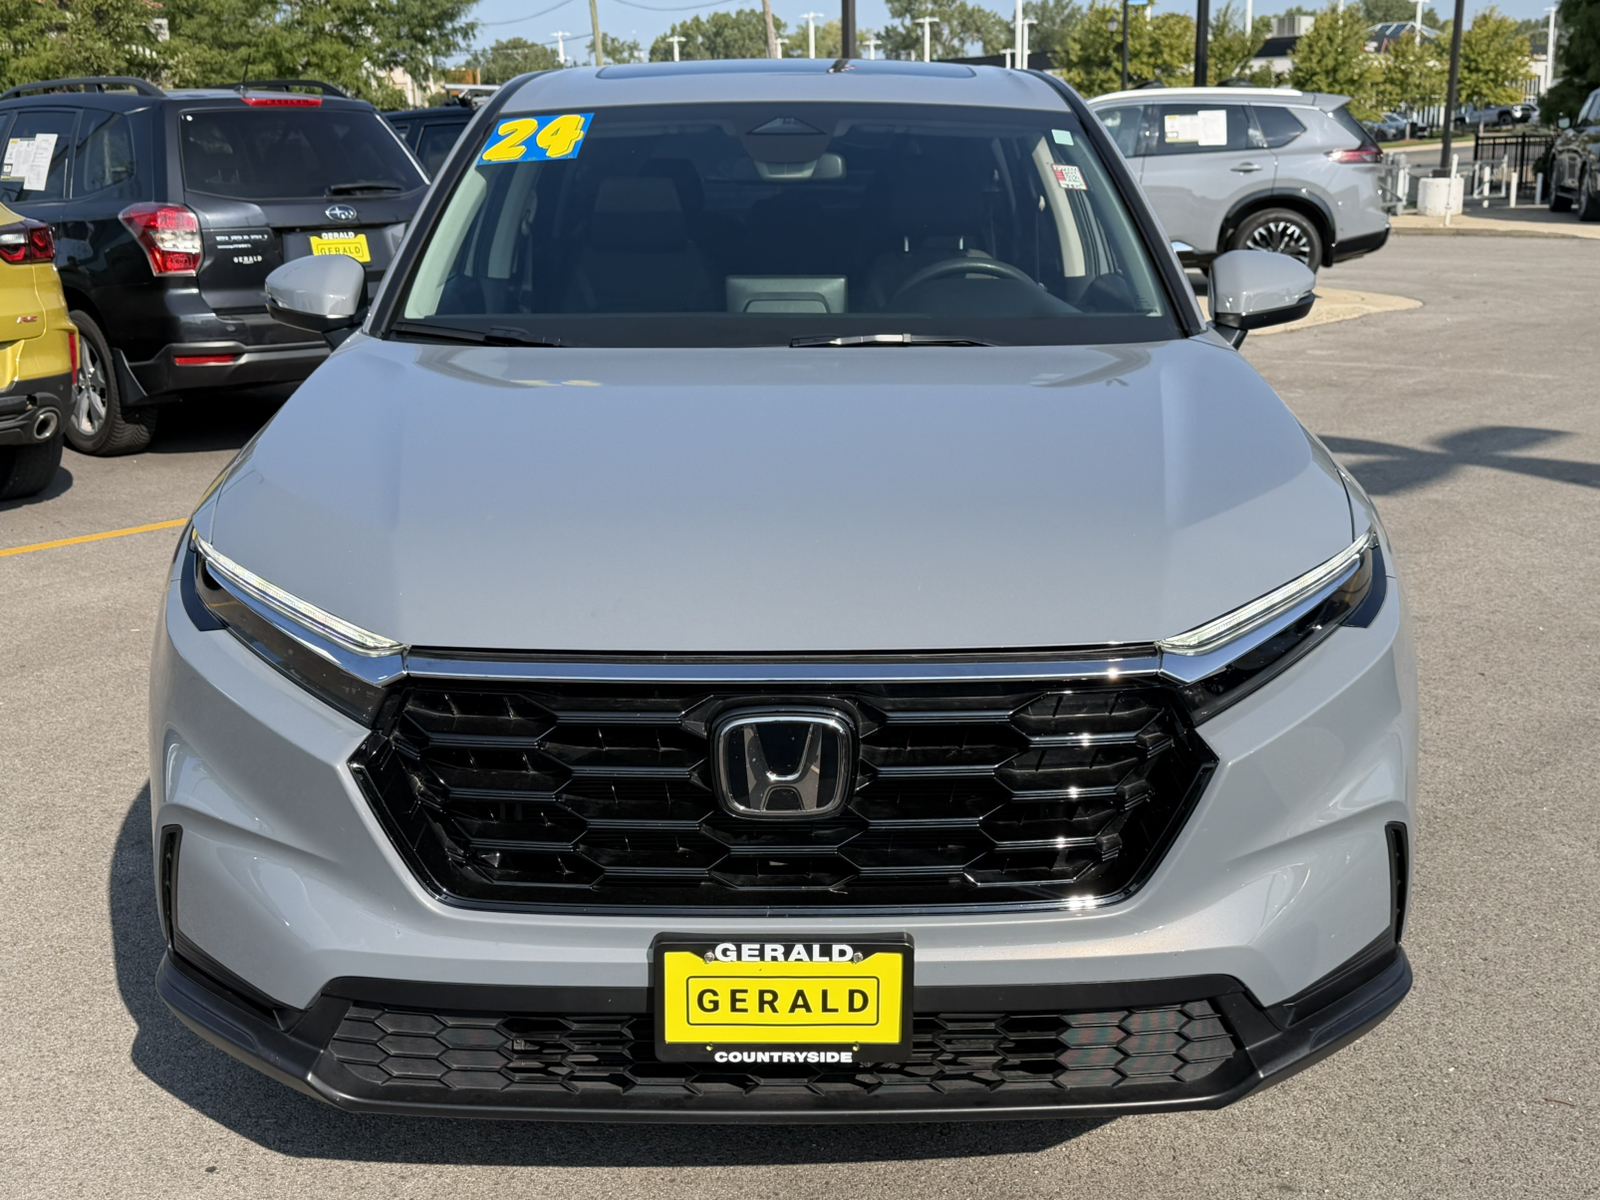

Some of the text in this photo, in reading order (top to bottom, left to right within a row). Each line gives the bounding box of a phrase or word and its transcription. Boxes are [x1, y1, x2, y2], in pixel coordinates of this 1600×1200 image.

[482, 114, 585, 162] 24
[321, 231, 355, 240] GERALD
[320, 246, 361, 255] GERALD
[714, 943, 854, 963] GERALD
[697, 988, 870, 1014] GERALD
[714, 1051, 853, 1063] COUNTRYSIDE
